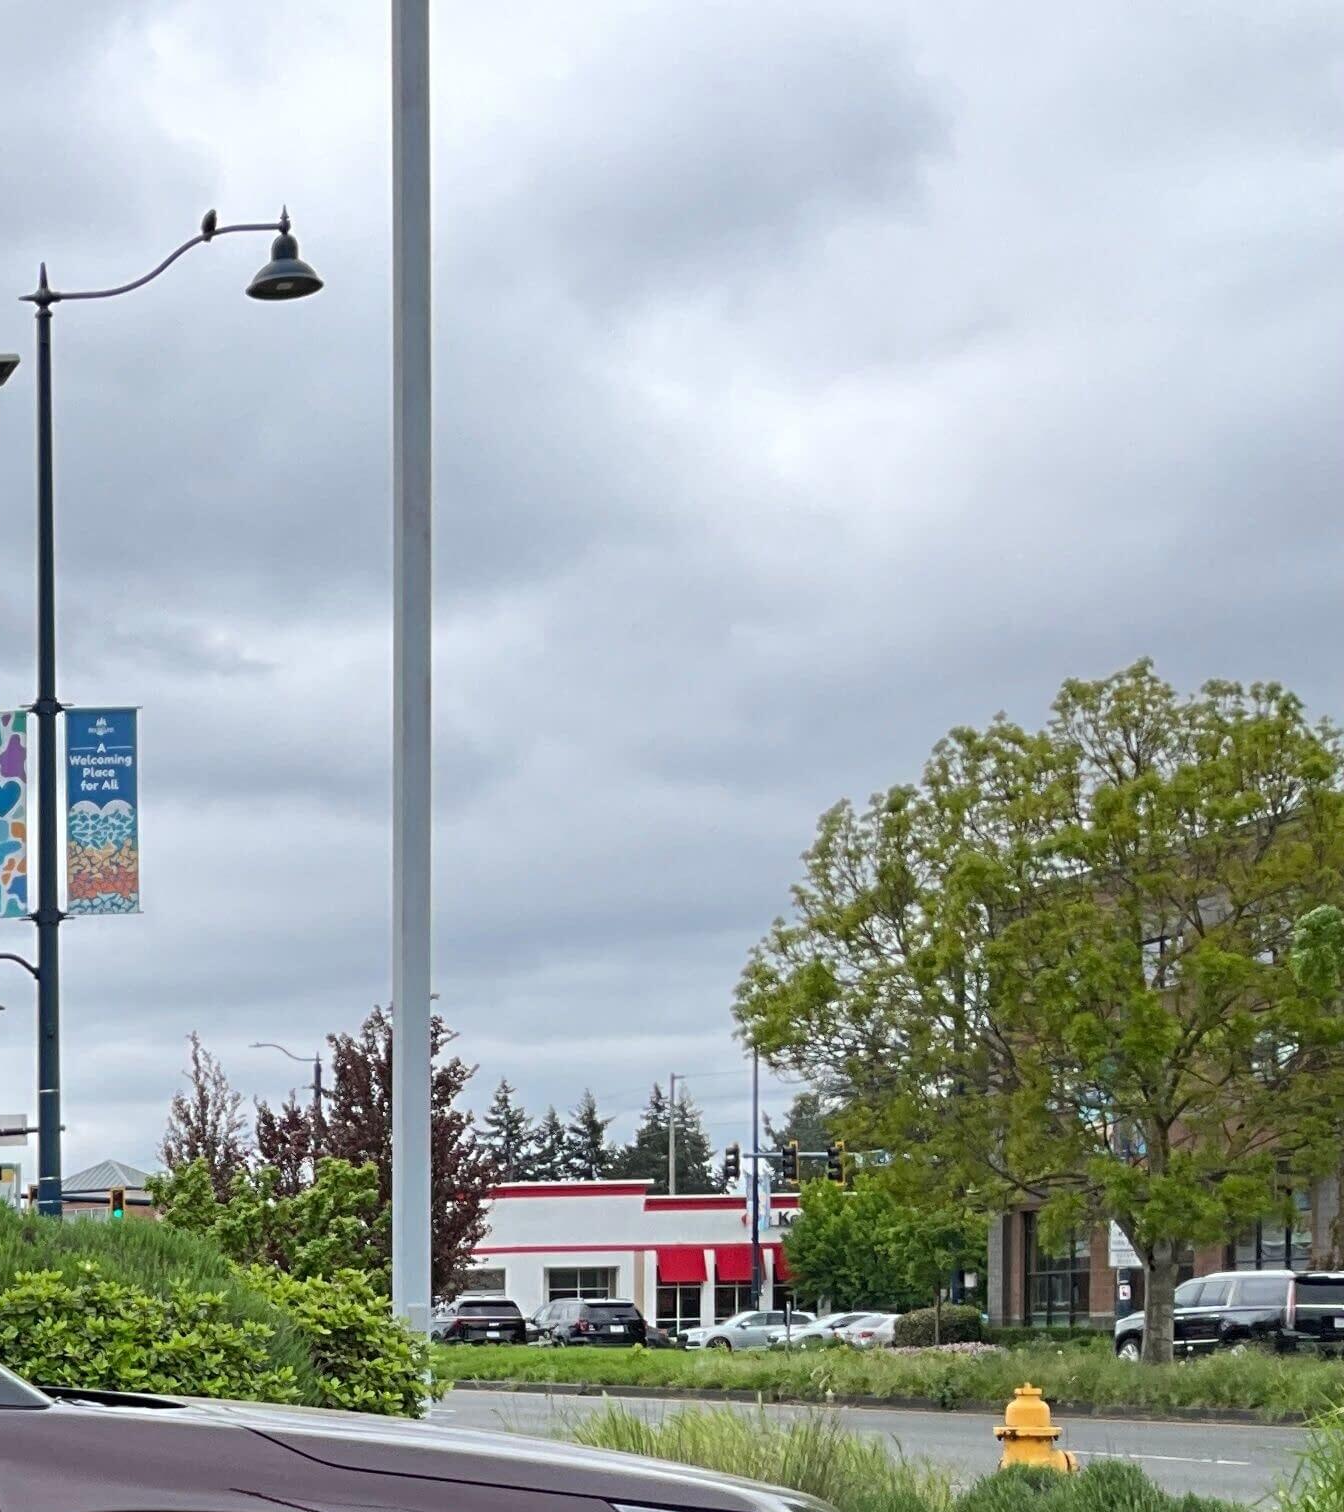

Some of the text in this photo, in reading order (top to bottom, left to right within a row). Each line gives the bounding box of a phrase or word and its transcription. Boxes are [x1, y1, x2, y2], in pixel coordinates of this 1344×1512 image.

[97, 742, 106, 753] A
[69, 754, 132, 767] Welcoming
[82, 766, 115, 778] Place
[80, 779, 119, 791] for All
